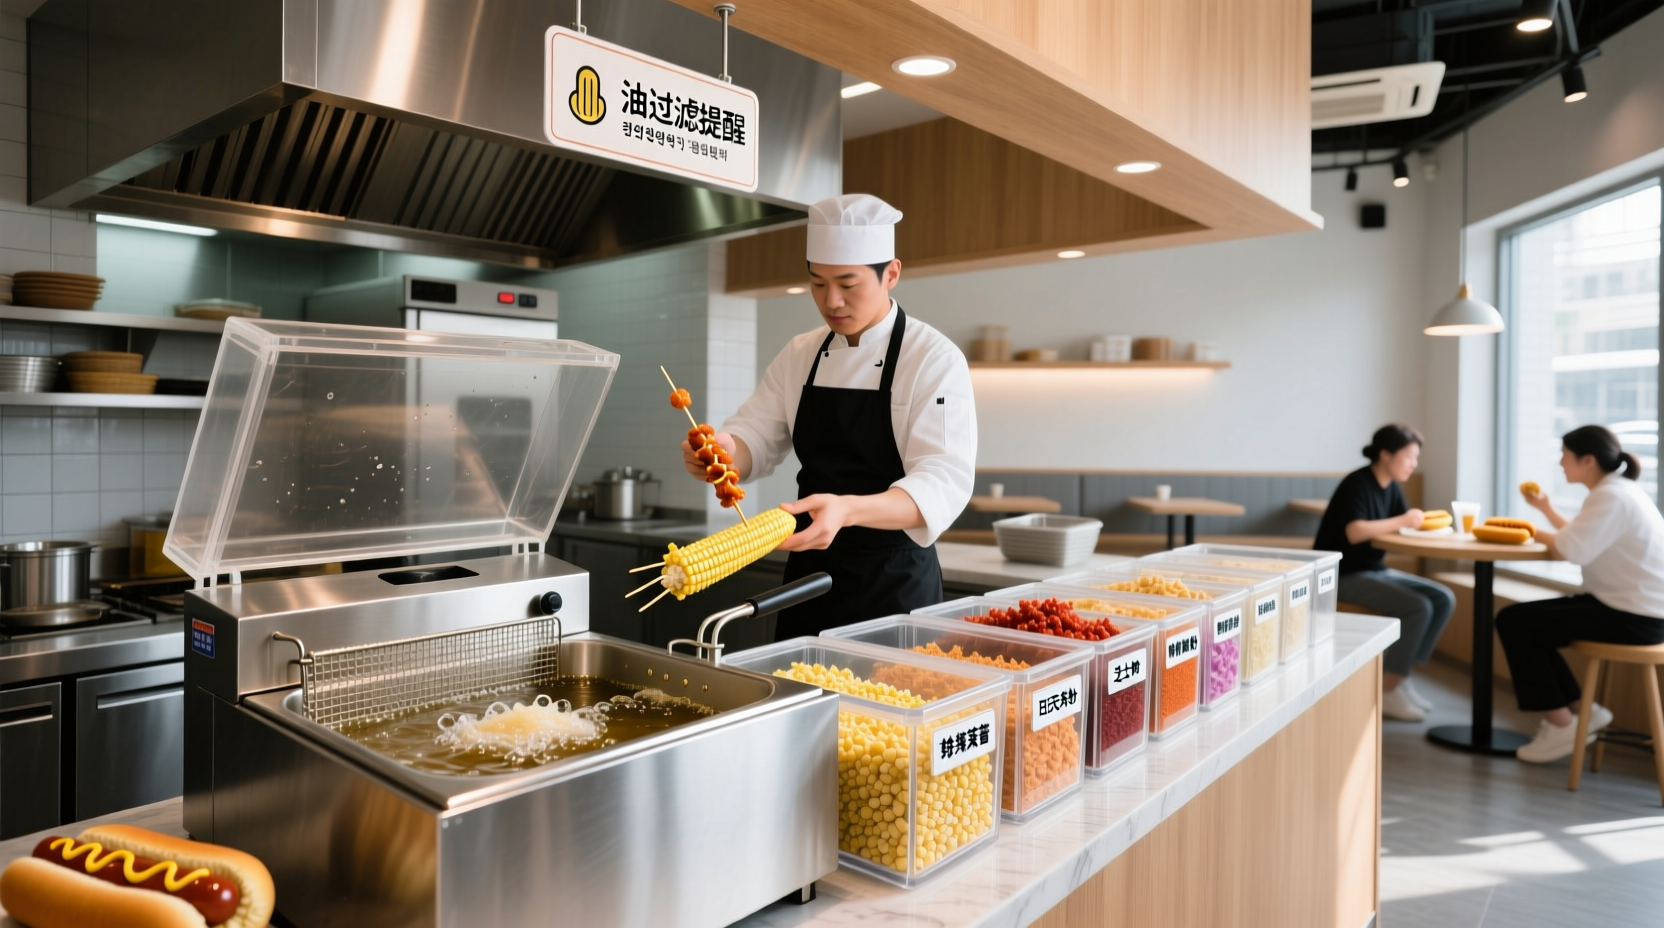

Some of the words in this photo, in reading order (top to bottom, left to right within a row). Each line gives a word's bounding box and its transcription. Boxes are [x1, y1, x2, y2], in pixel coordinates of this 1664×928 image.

[621, 79, 746, 146] 油过滤提醒
